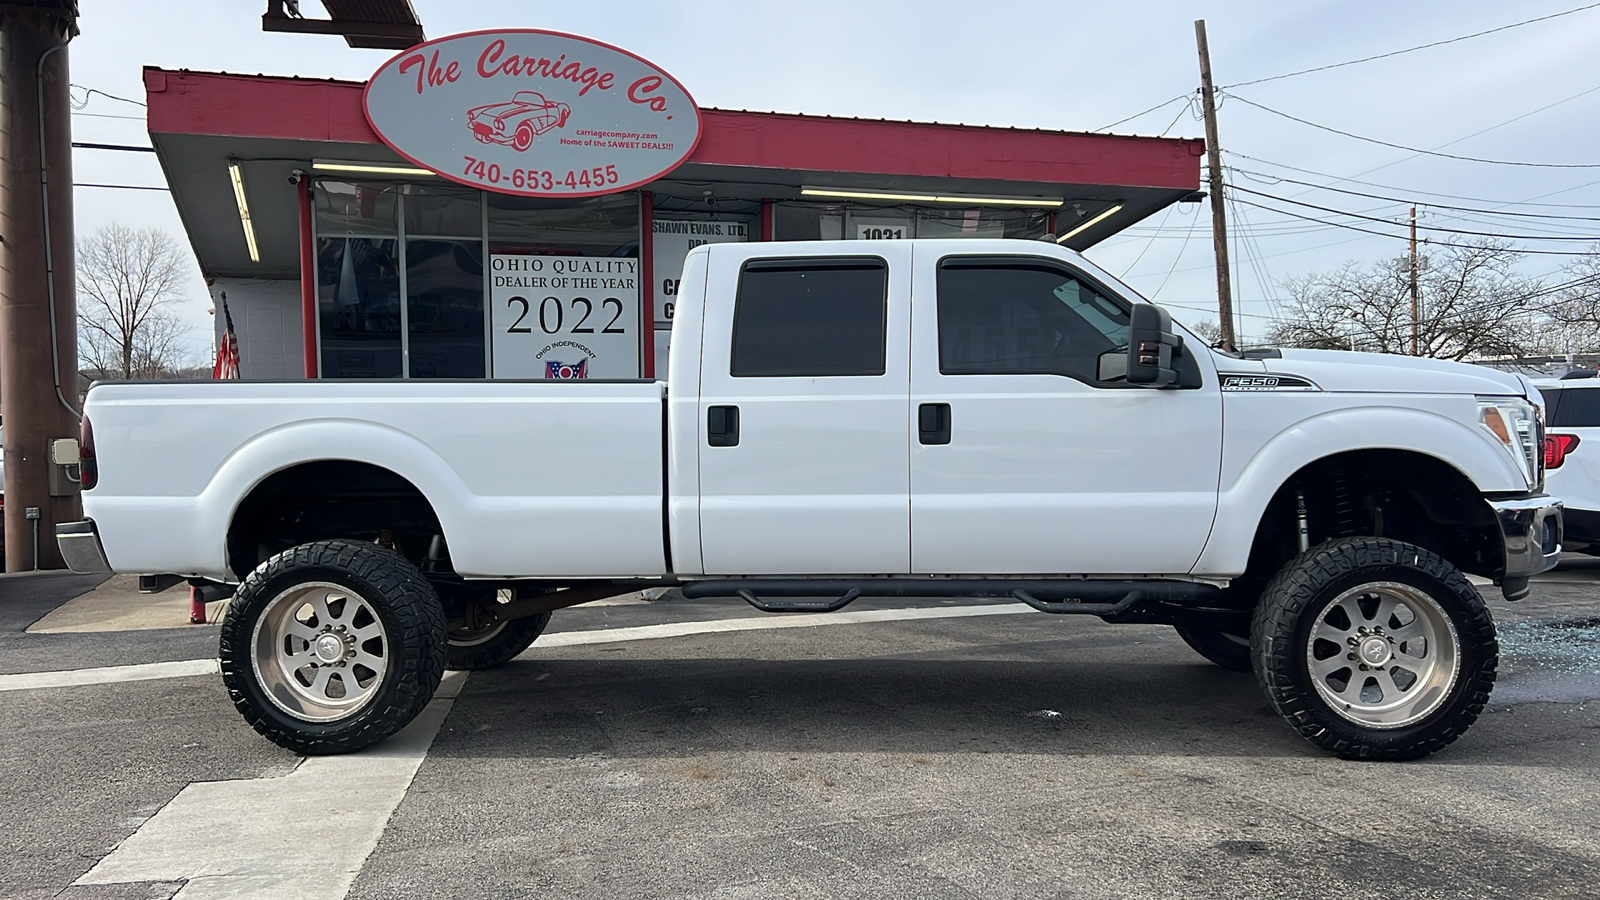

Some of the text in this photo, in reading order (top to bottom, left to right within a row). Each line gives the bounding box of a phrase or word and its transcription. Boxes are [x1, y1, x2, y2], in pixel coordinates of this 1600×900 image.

[399, 39, 673, 120] The Carriage Co.
[576, 129, 658, 140] carriagecompany.com
[560, 138, 582, 146] Home
[607, 141, 640, 149] SAWEET
[641, 142, 674, 150] DEALS!!!
[462, 156, 619, 191] 740-653-4455
[652, 221, 688, 234] SHAWN
[727, 225, 747, 237] LTD.
[492, 258, 637, 275] OHIO QUALITY
[495, 276, 635, 289] DEALER OF THE YEAR
[507, 296, 625, 334] 2022
[535, 340, 597, 360] OHIO INDEPENDENT
